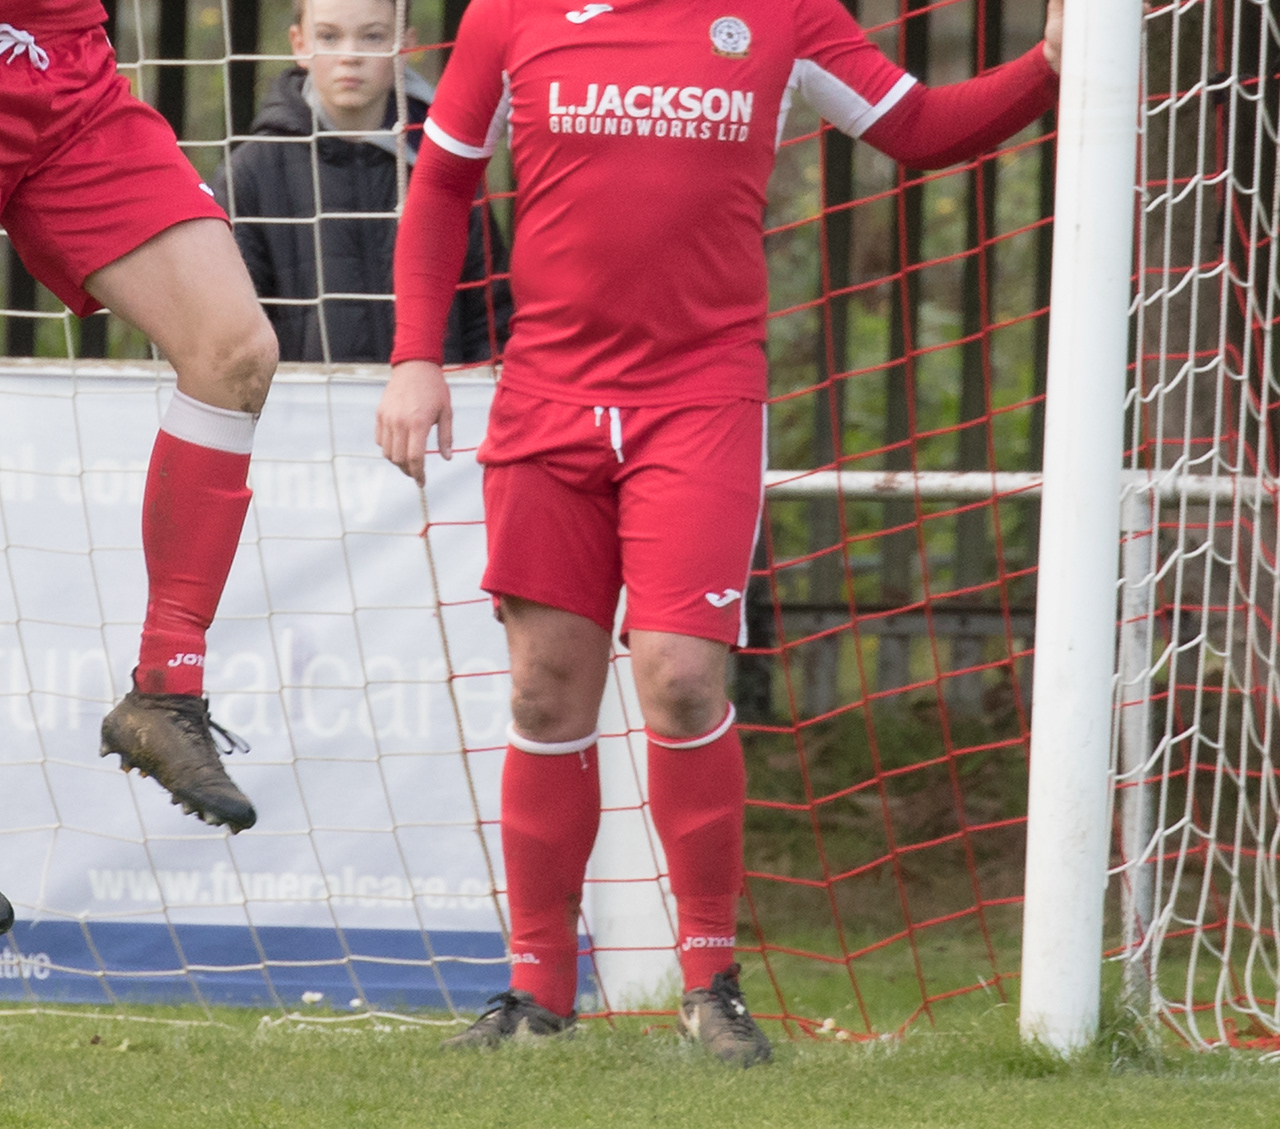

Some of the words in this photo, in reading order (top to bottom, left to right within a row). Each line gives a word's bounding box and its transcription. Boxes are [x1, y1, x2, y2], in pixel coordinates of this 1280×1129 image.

[549, 82, 754, 123] L.JACKSON
[549, 115, 711, 140] GROUNDWORKS
[717, 122, 749, 142] LTD
